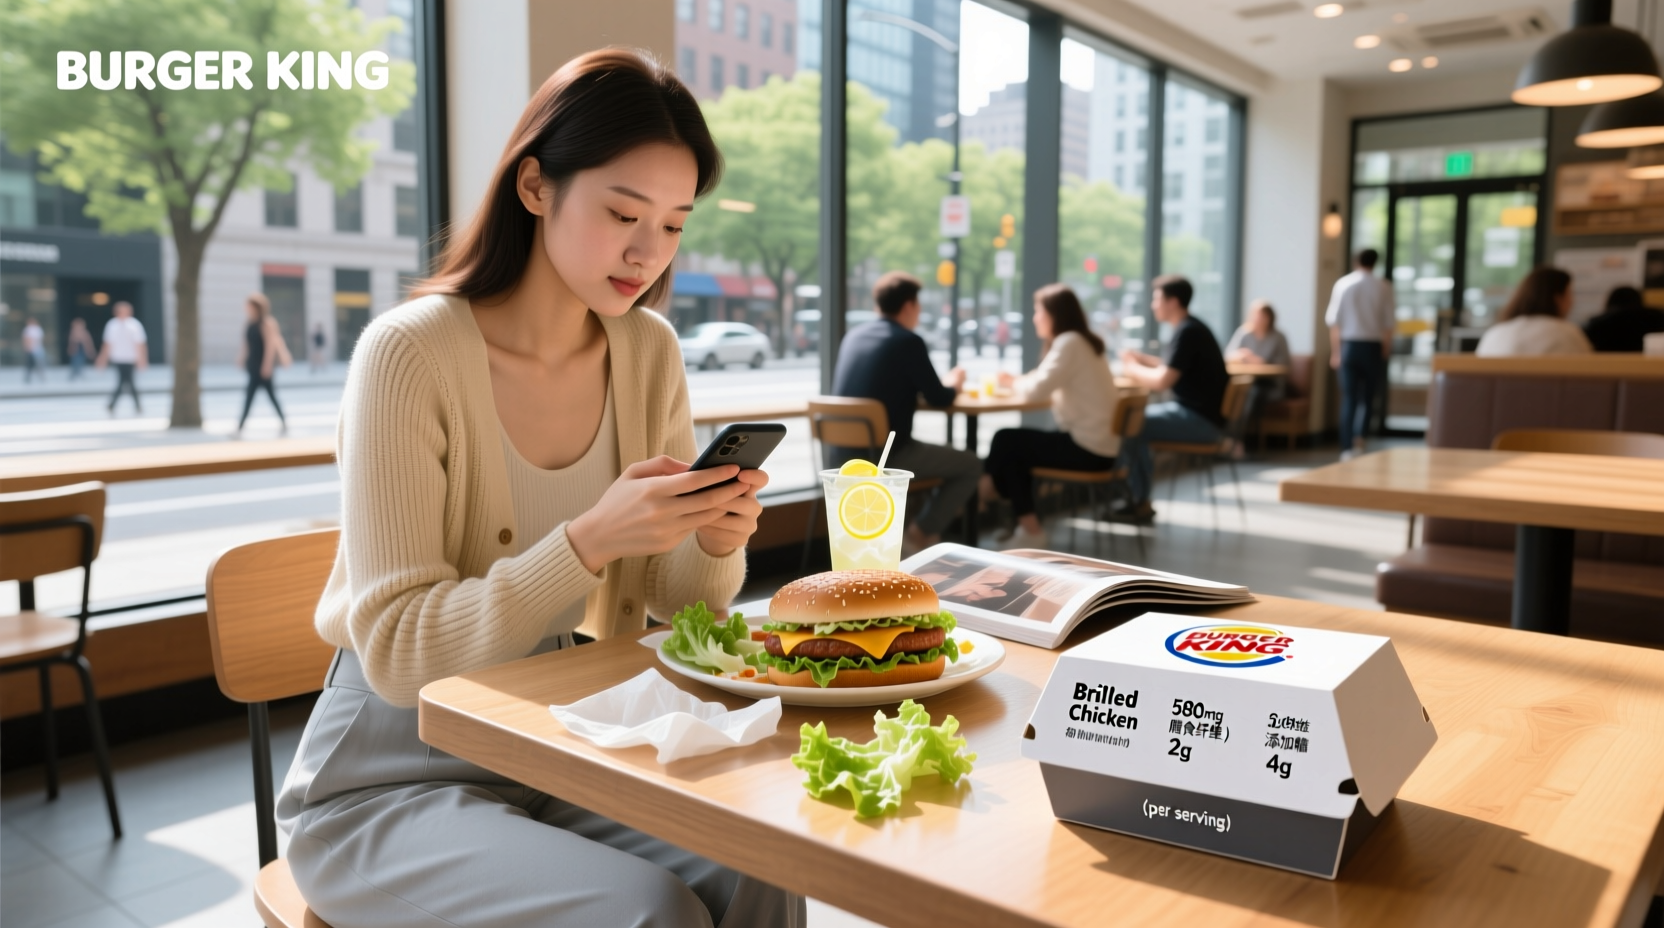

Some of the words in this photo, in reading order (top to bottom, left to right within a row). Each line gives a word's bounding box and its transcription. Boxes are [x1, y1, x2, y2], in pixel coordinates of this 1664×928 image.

[1175, 640, 1289, 654] KING
[1073, 682, 1139, 708] Brilled
[1069, 704, 1138, 730] Chicken
[1172, 698, 1224, 726] 580mg
[1168, 738, 1192, 762] 2g
[1266, 754, 1292, 779] 4g
[1143, 799, 1171, 819] (per
[1174, 811, 1231, 832] serving)
